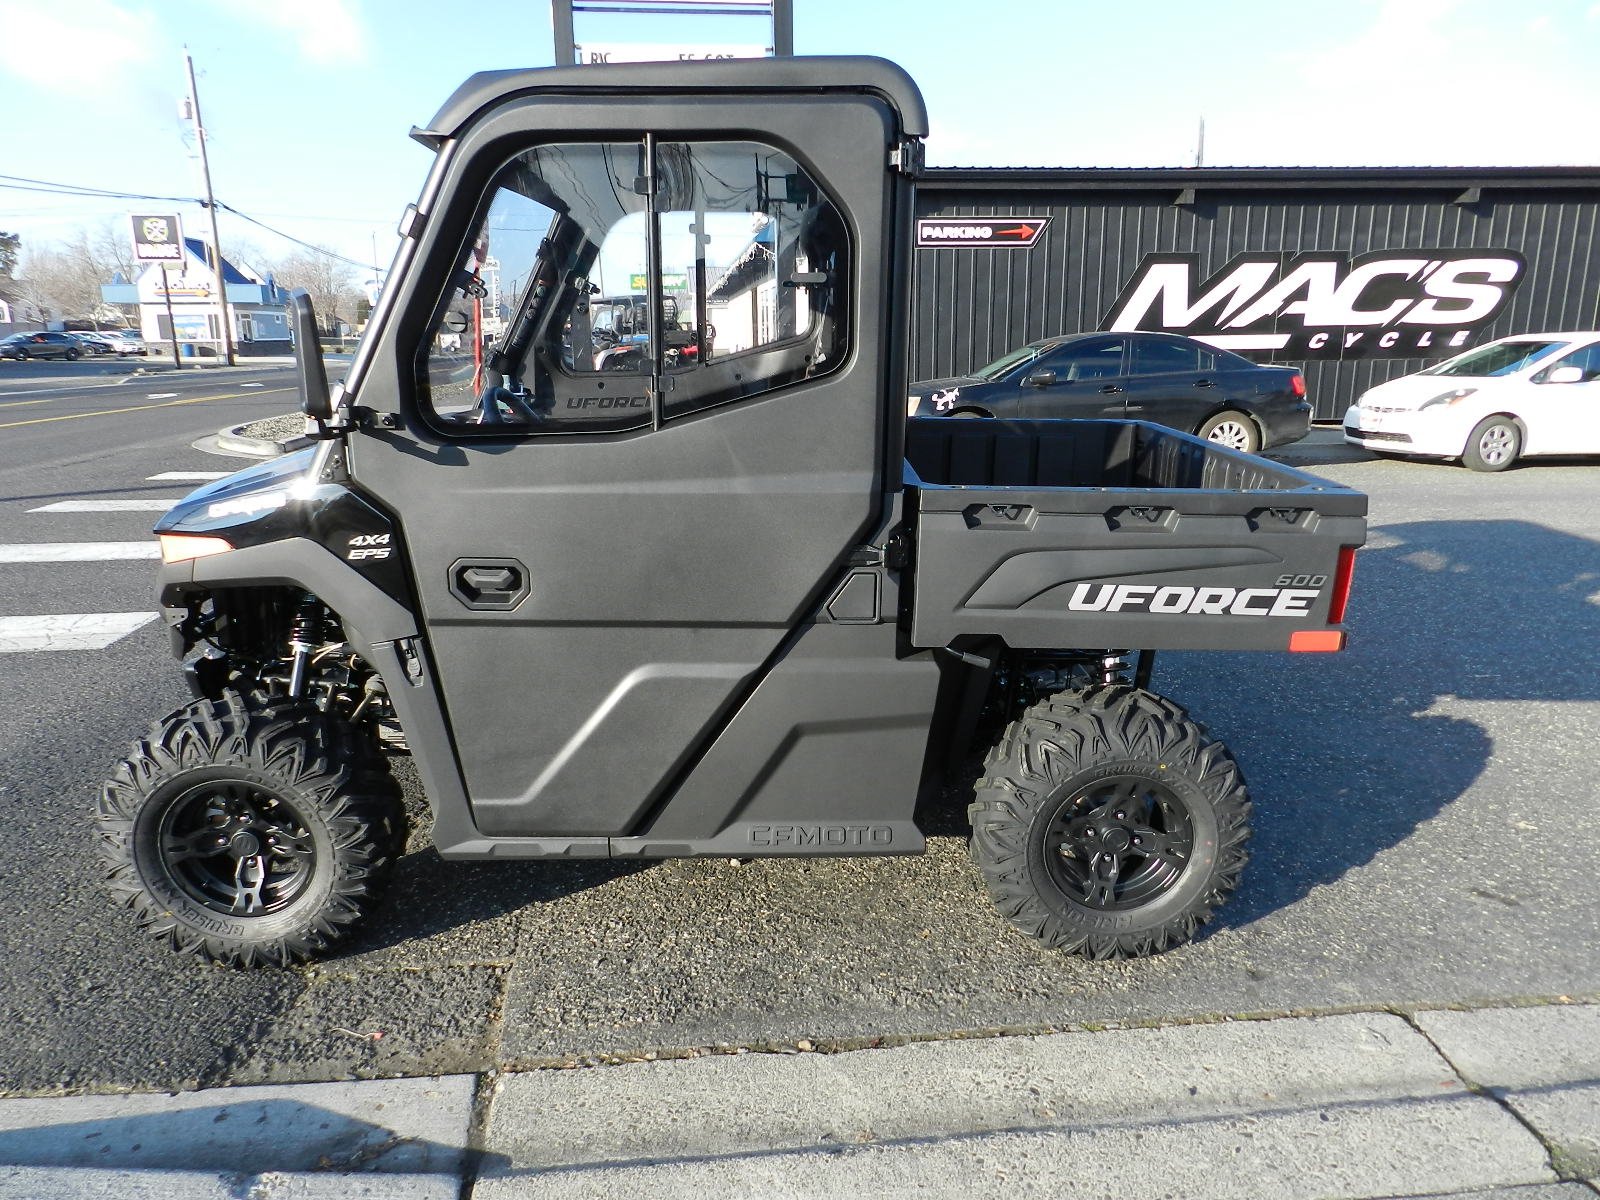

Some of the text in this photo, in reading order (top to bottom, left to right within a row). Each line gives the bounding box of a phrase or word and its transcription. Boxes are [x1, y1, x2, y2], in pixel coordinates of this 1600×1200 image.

[922, 226, 993, 239] PARKING
[1109, 258, 1519, 332] MAC'S
[1308, 330, 1471, 349] CYCLE
[348, 547, 392, 560] EPS
[1274, 574, 1328, 587] 600
[1067, 583, 1321, 617] UFORCE
[749, 825, 893, 847] CFMOTO
